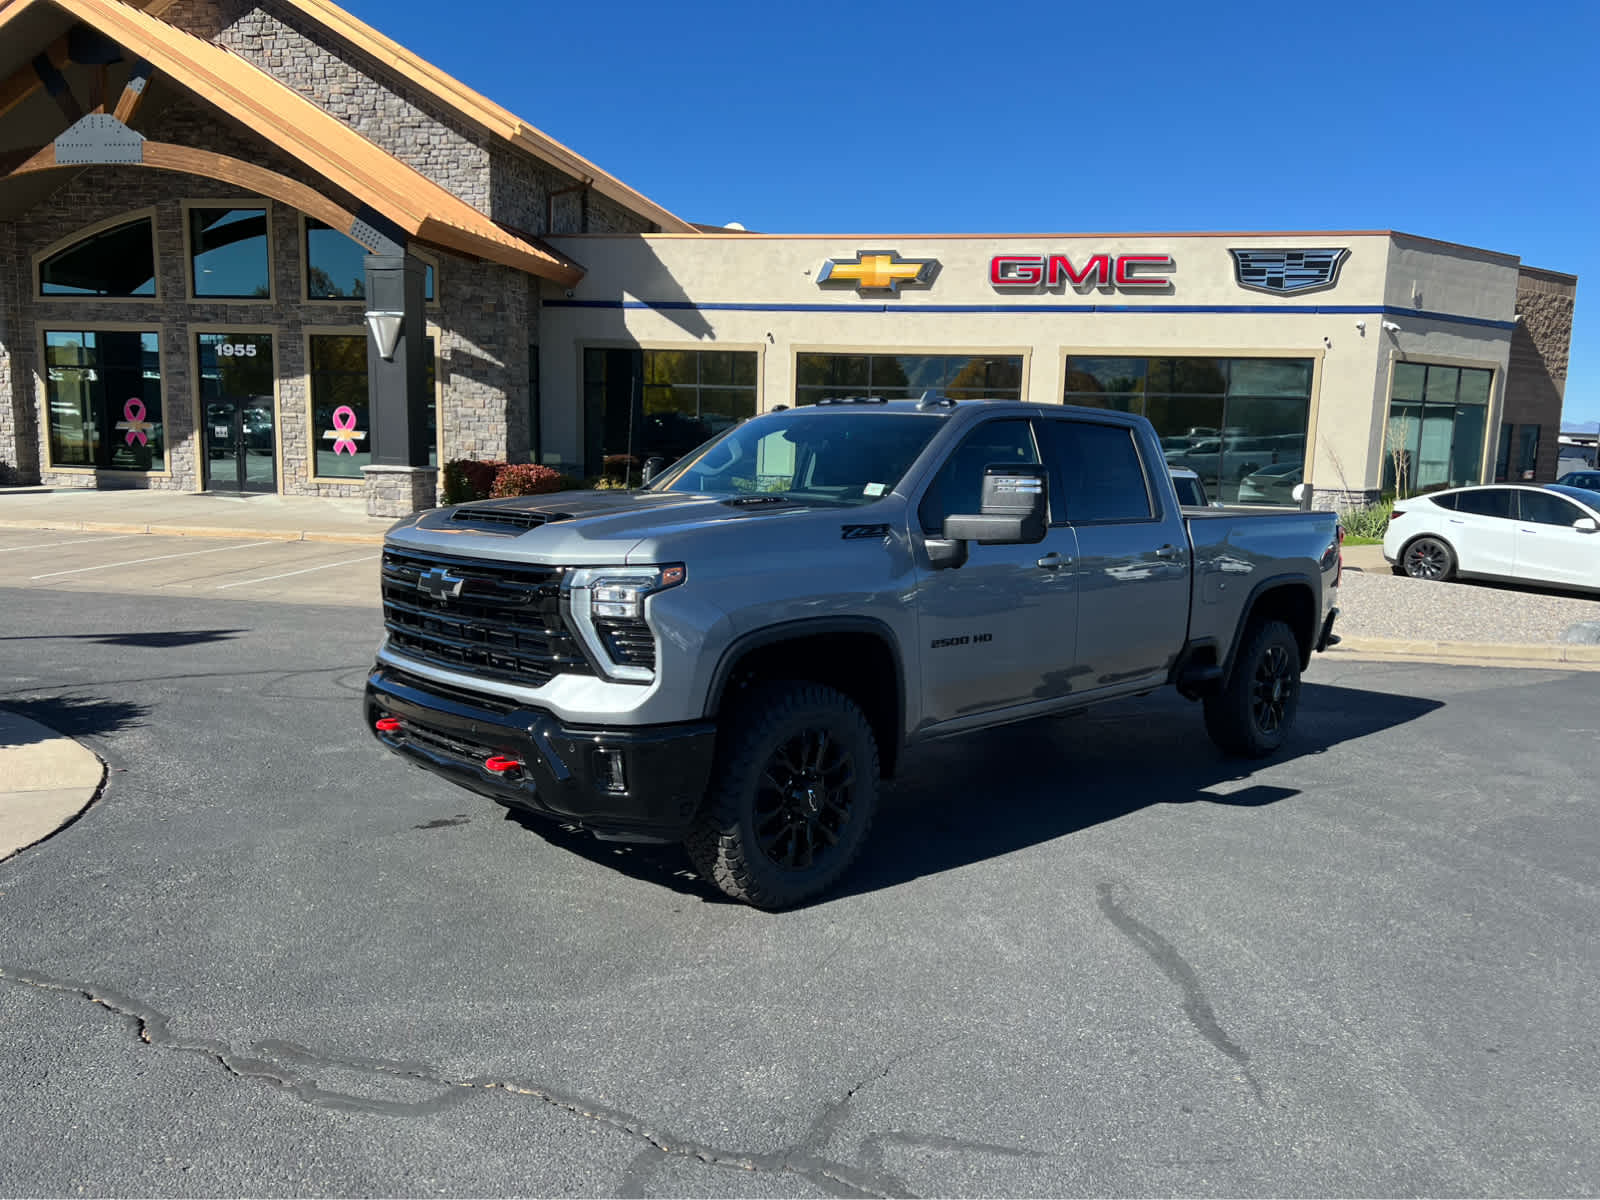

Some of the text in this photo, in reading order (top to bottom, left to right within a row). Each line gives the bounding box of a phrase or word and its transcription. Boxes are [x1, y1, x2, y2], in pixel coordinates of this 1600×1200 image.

[988, 253, 1173, 289] GMC
[214, 343, 257, 357] 1955
[931, 633, 993, 648] 2500 HD
